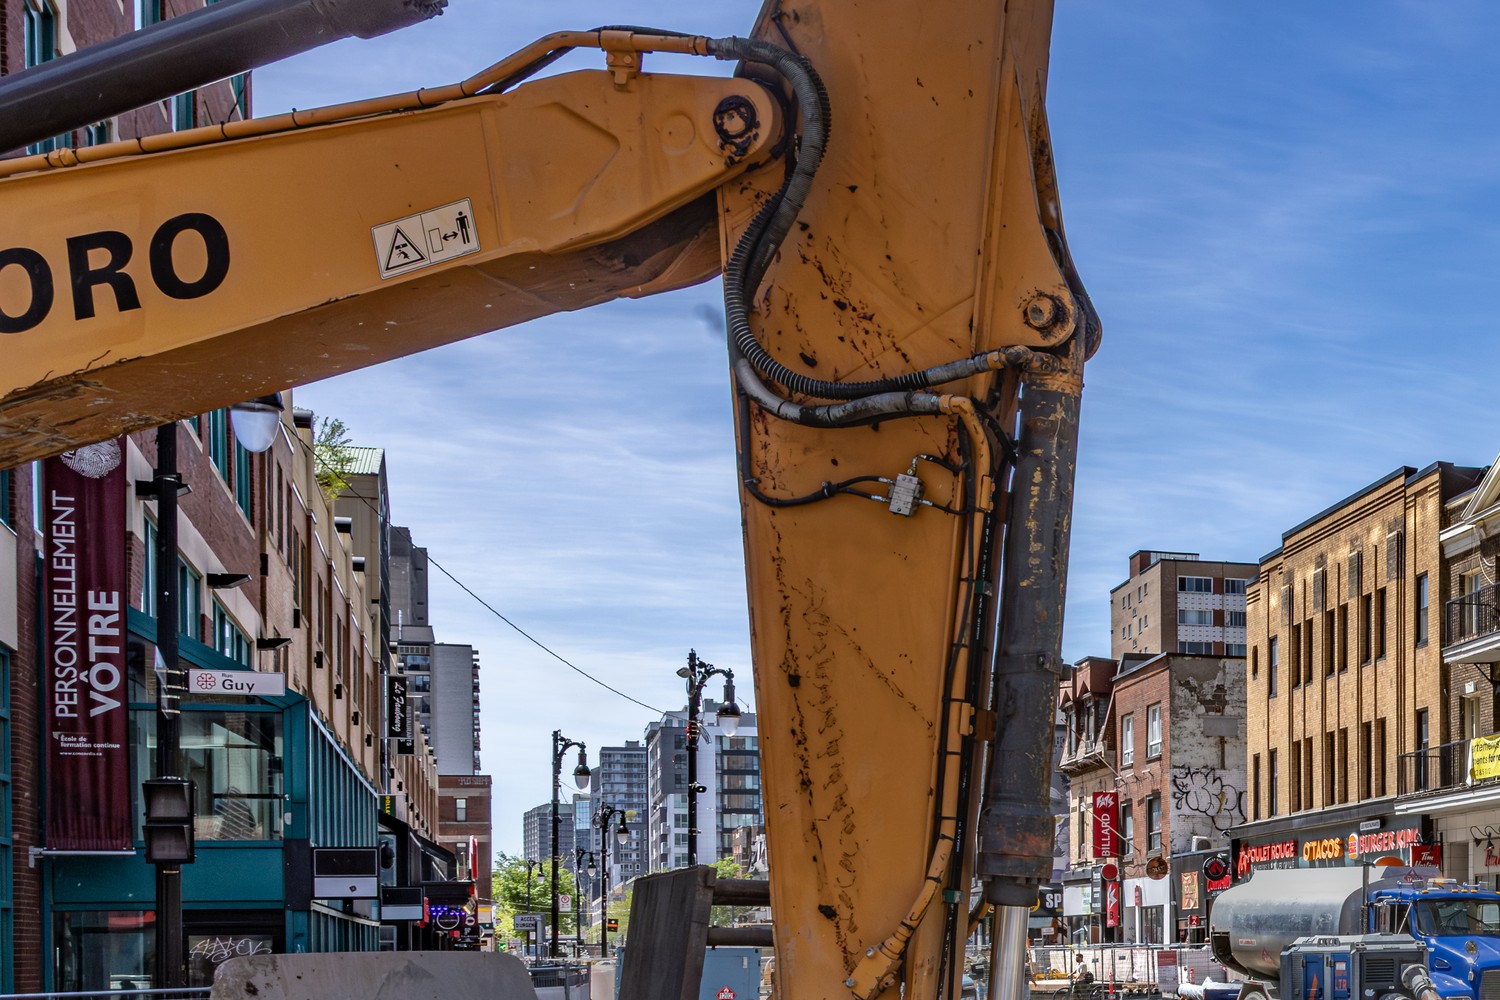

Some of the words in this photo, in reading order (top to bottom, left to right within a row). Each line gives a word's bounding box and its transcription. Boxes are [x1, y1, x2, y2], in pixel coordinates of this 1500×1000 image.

[52, 489, 78, 718] PERSONNELLEMENT
[79, 590, 121, 718] VÔTRE
[222, 679, 255, 693] Guy
[1102, 813, 1111, 857] BILLARD
[1360, 831, 1396, 854] BURGER
[1396, 828, 1420, 849] KING
[1247, 845, 1271, 862] POULET
[1271, 841, 1297, 860] ROUGE
[1421, 852, 1435, 861] Tim
